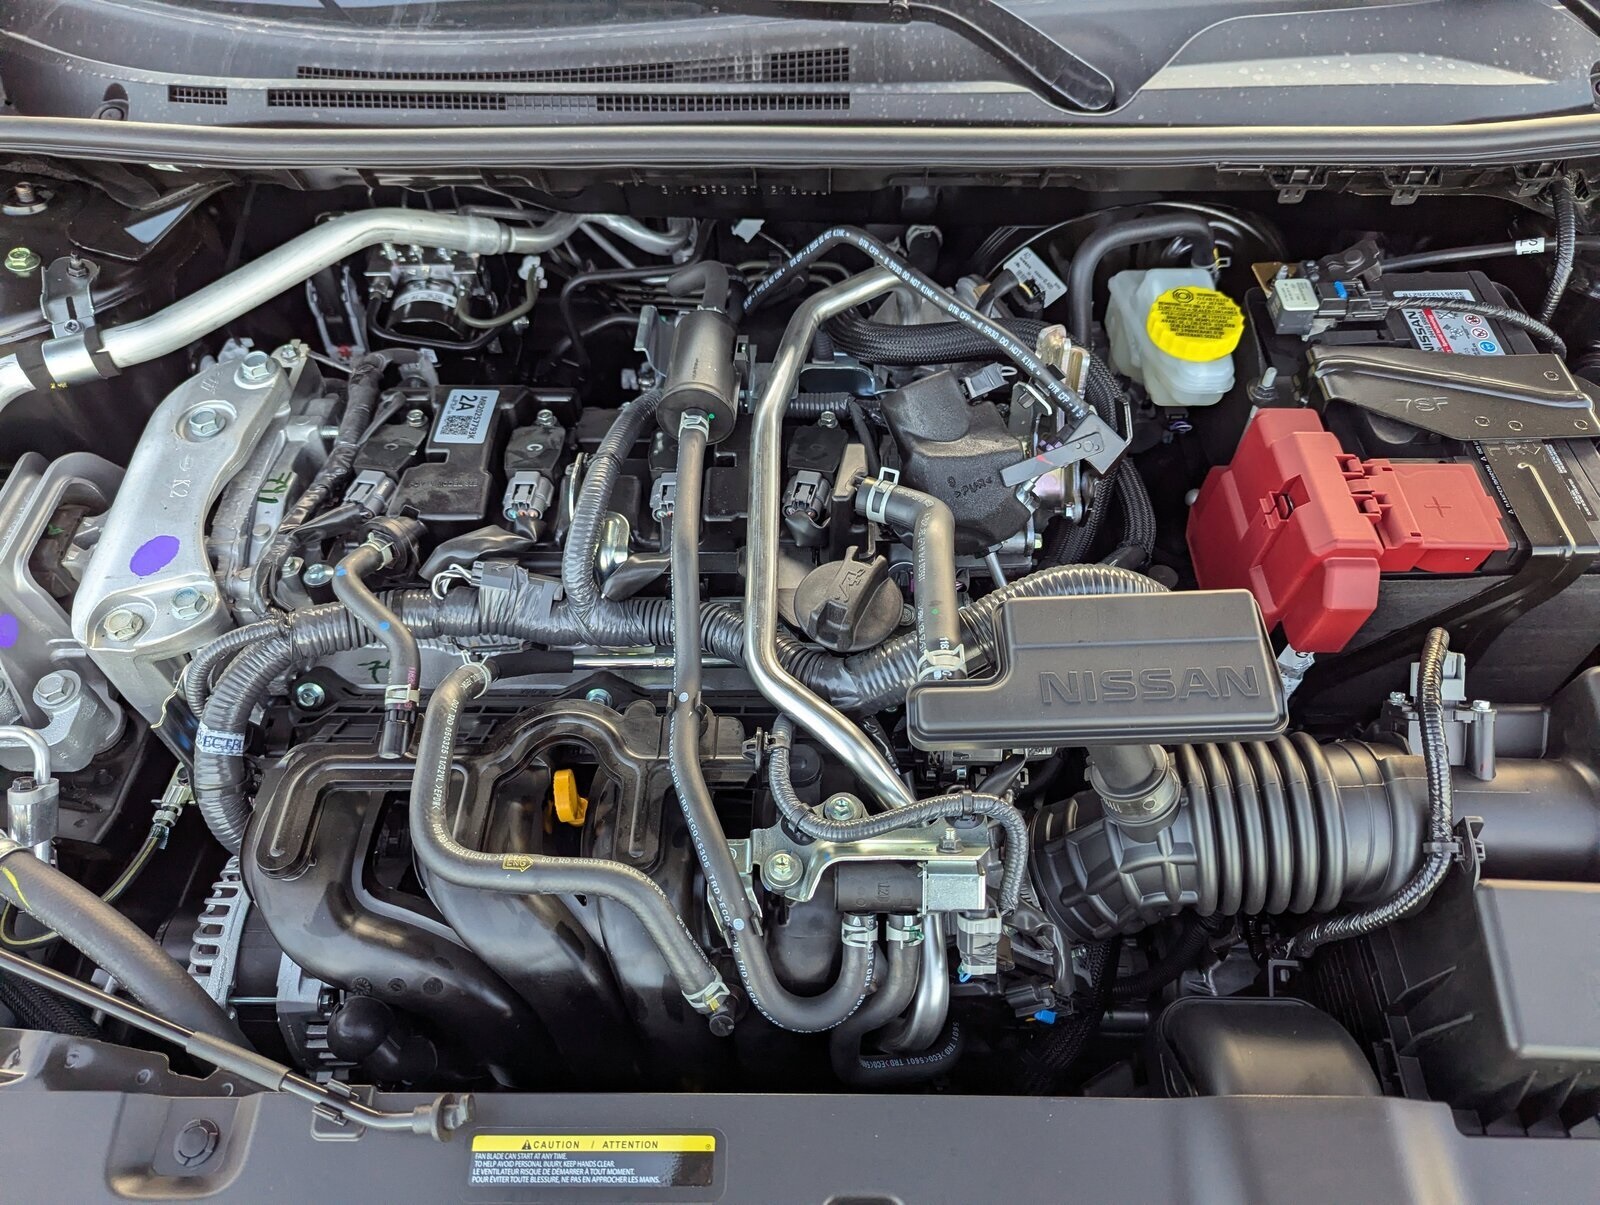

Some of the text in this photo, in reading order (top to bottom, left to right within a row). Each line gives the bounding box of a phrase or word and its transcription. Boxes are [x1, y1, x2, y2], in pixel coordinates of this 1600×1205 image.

[909, 276, 921, 289] NOT
[920, 284, 936, 299] KINK
[948, 303, 960, 316] DTR
[959, 310, 972, 322] CFP
[983, 325, 1000, 340] 5930
[998, 336, 1009, 347] DO
[1008, 344, 1023, 361] NOT
[1021, 356, 1038, 373] KINK
[1406, 311, 1435, 351] NISSAN
[455, 394, 479, 412] 2A
[1047, 382, 1061, 395] DTR
[1057, 392, 1071, 404] CFP
[1040, 665, 1261, 704] NISSAN
[533, 1141, 580, 1149] CAUTION
[602, 1141, 659, 1149] ATTENTION
[475, 1152, 486, 1160] FAN
[486, 1152, 504, 1160] BLADE
[504, 1152, 517, 1160] CAN
[518, 1152, 533, 1160] START
[534, 1152, 541, 1160] AT
[541, 1152, 553, 1160] ANY
[475, 1160, 482, 1168] TO
[483, 1160, 497, 1168] HELP
[497, 1160, 514, 1168] AVOID
[515, 1160, 542, 1168] PERSONAL
[563, 1160, 576, 1168] KEEP
[577, 1160, 596, 1168] HANDS
[472, 1168, 480, 1176] LE
[480, 1168, 520, 1176] VENTILATEUR
[520, 1168, 542, 1176] RISQUE
[542, 1168, 550, 1176] DE
[552, 1168, 584, 1176] DÉMARRER
[590, 1168, 606, 1176] TOUT
